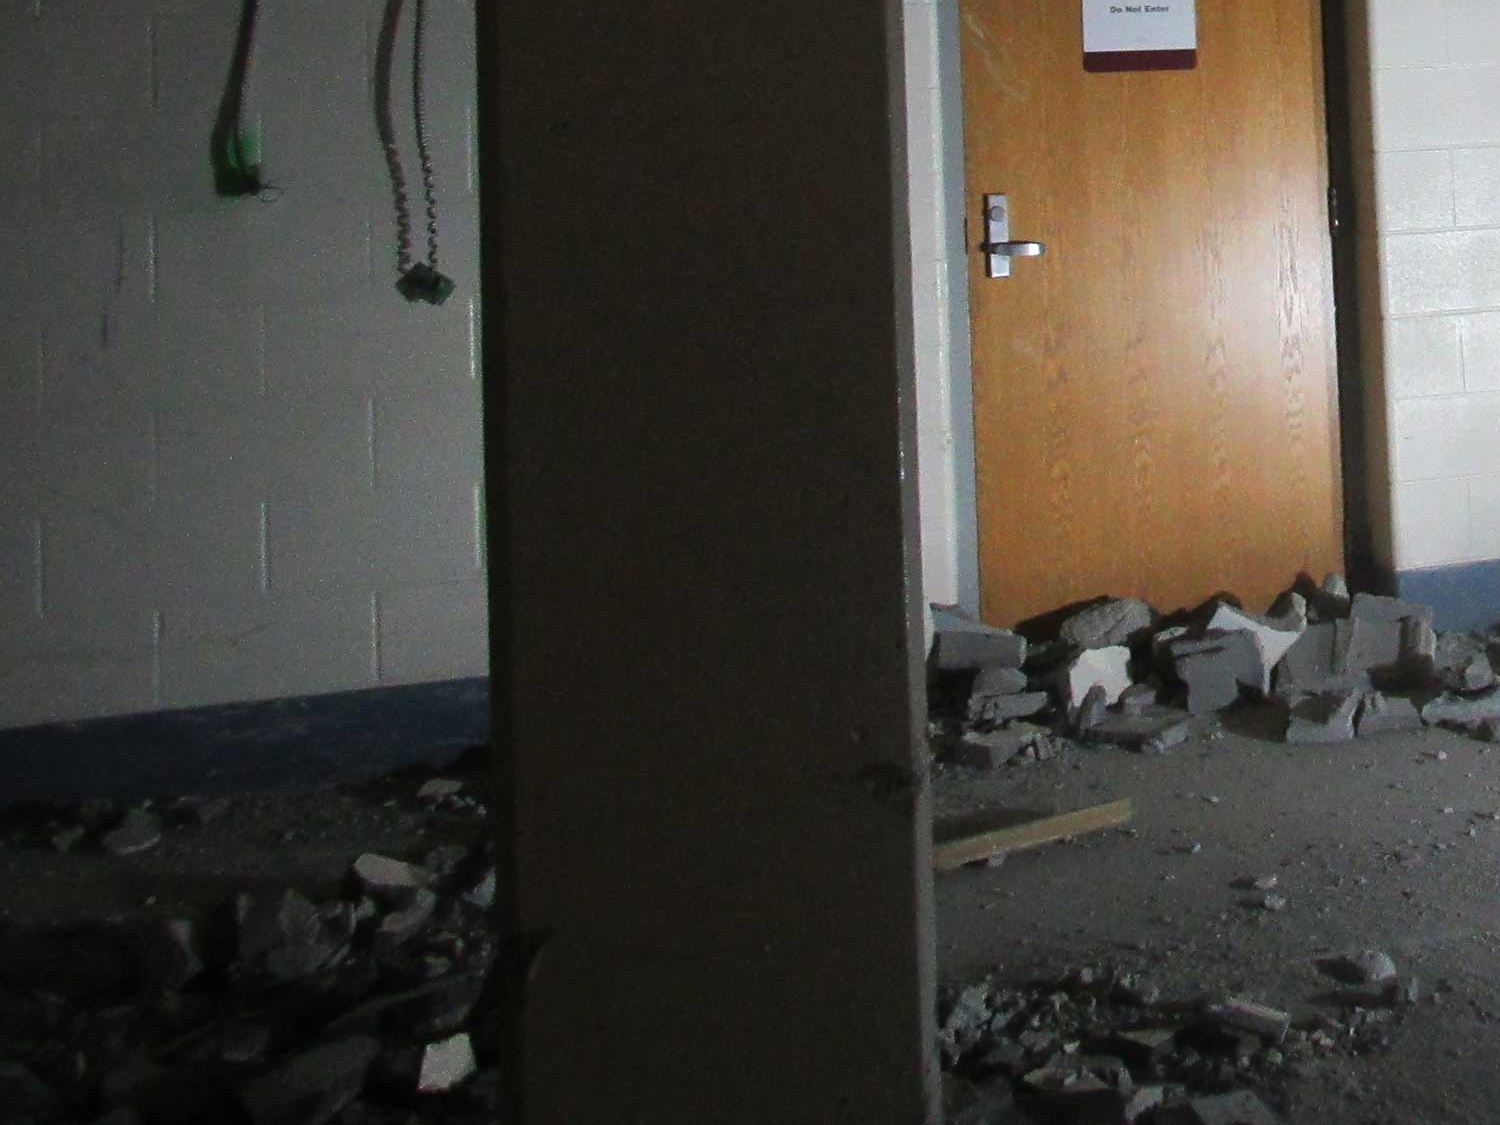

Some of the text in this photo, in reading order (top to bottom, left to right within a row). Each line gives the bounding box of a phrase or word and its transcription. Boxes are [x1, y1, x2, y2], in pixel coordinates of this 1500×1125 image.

[1110, 4, 1169, 13] Do Not Enter
